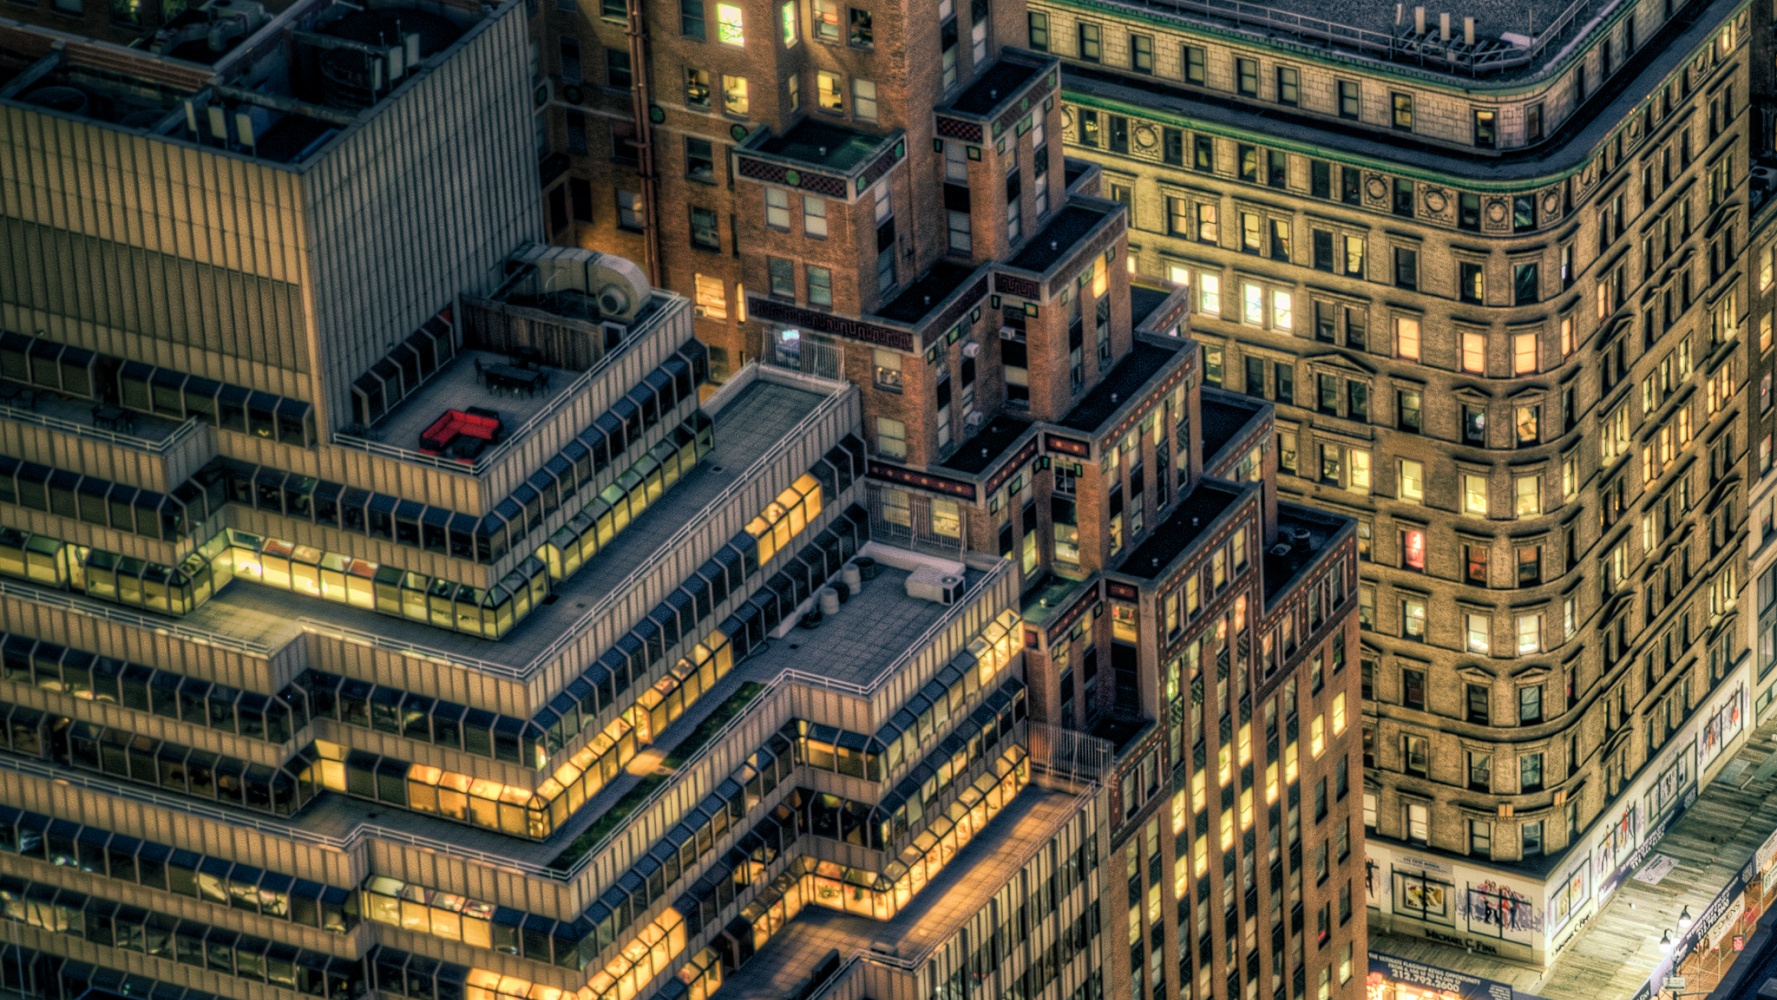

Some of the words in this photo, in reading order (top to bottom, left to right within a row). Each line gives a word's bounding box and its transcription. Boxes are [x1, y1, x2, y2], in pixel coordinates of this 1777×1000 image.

[1425, 928, 1463, 946] MICHAEL
[1476, 940, 1498, 954] FINA
[1392, 968, 1460, 993] 212.792.2600
